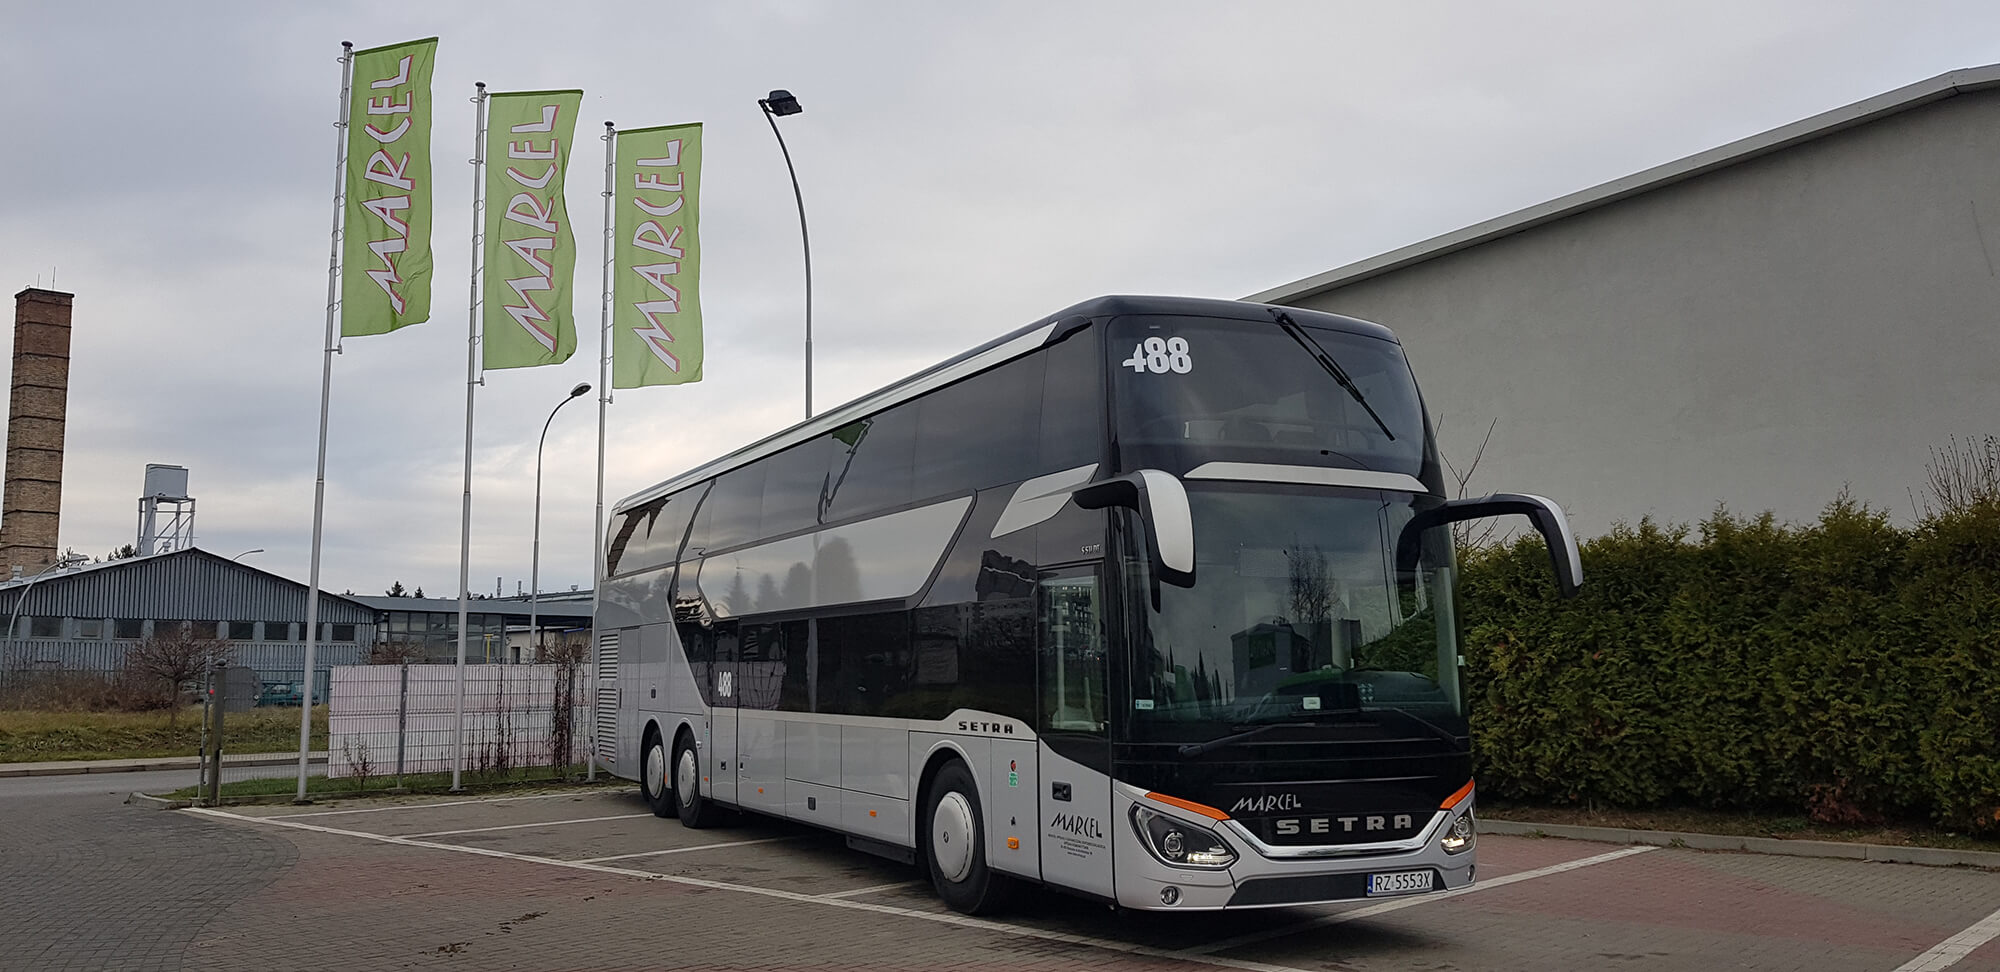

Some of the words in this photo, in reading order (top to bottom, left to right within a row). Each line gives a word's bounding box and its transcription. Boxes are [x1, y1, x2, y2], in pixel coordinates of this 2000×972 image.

[360, 54, 417, 316] MARCEL
[502, 104, 560, 354] MARCEL
[631, 139, 685, 374] MARCEL
[1122, 336, 1193, 374] 488
[717, 671, 732, 698] 488
[958, 721, 1013, 734] SETRA
[1230, 793, 1302, 812] MARCEL
[1050, 812, 1103, 839] MARCEL
[1276, 814, 1412, 835] SETRA
[1375, 875, 1391, 891] RZ
[1395, 872, 1431, 890] 5553X
